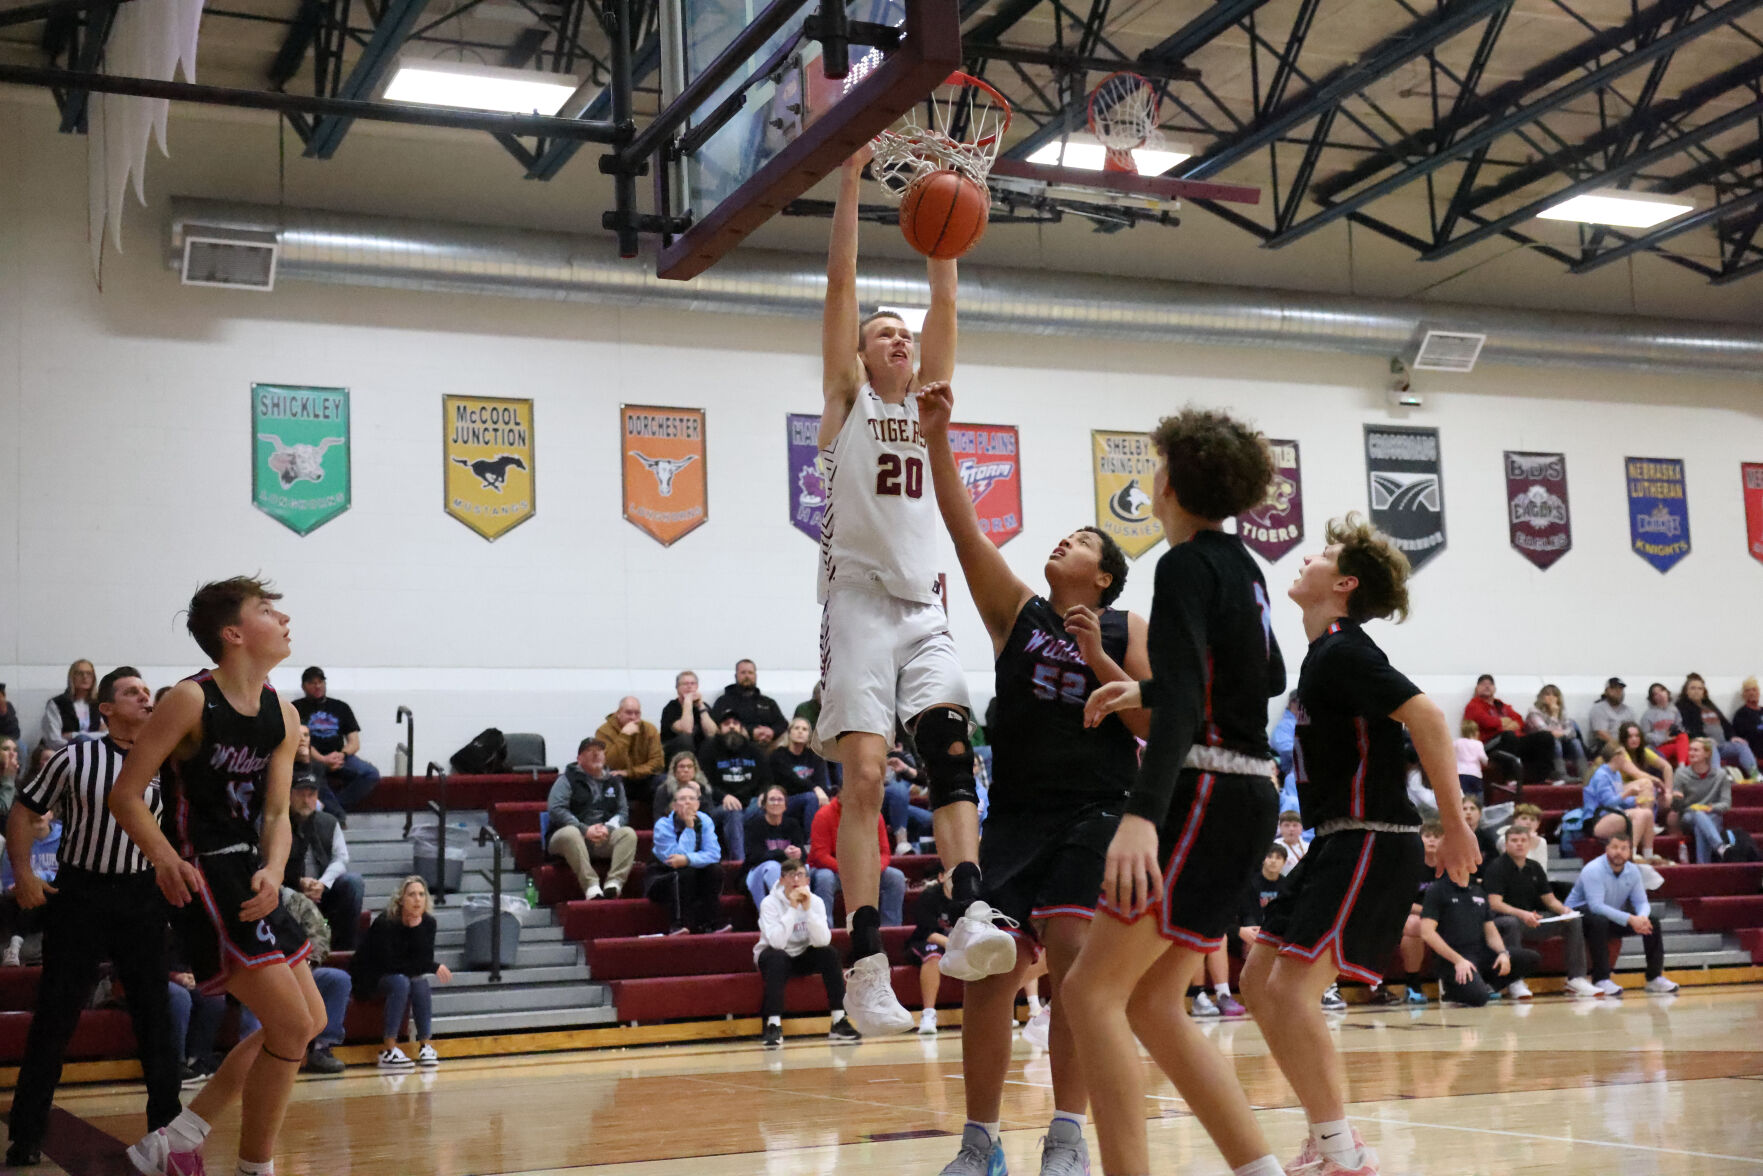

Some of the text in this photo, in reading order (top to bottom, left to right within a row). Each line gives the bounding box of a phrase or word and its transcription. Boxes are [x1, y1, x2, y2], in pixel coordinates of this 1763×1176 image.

[260, 394, 343, 420] SHICKLEY
[456, 404, 521, 426] McCOOL
[452, 425, 527, 447] JUNCTION
[626, 413, 700, 440] DORCHESTER
[977, 431, 1016, 456] PLAINS
[1106, 438, 1149, 456] SHELBY
[876, 452, 924, 499] 20
[1100, 456, 1133, 474] RISING
[1509, 459, 1563, 481] BDS
[1628, 461, 1681, 480] NEBRASKA
[1631, 480, 1683, 499] LUTHERAN
[453, 498, 529, 515] MUSTANGS
[978, 513, 1018, 533] ORM
[1105, 520, 1161, 537] HUSKIES
[1242, 521, 1299, 543] TIGERS
